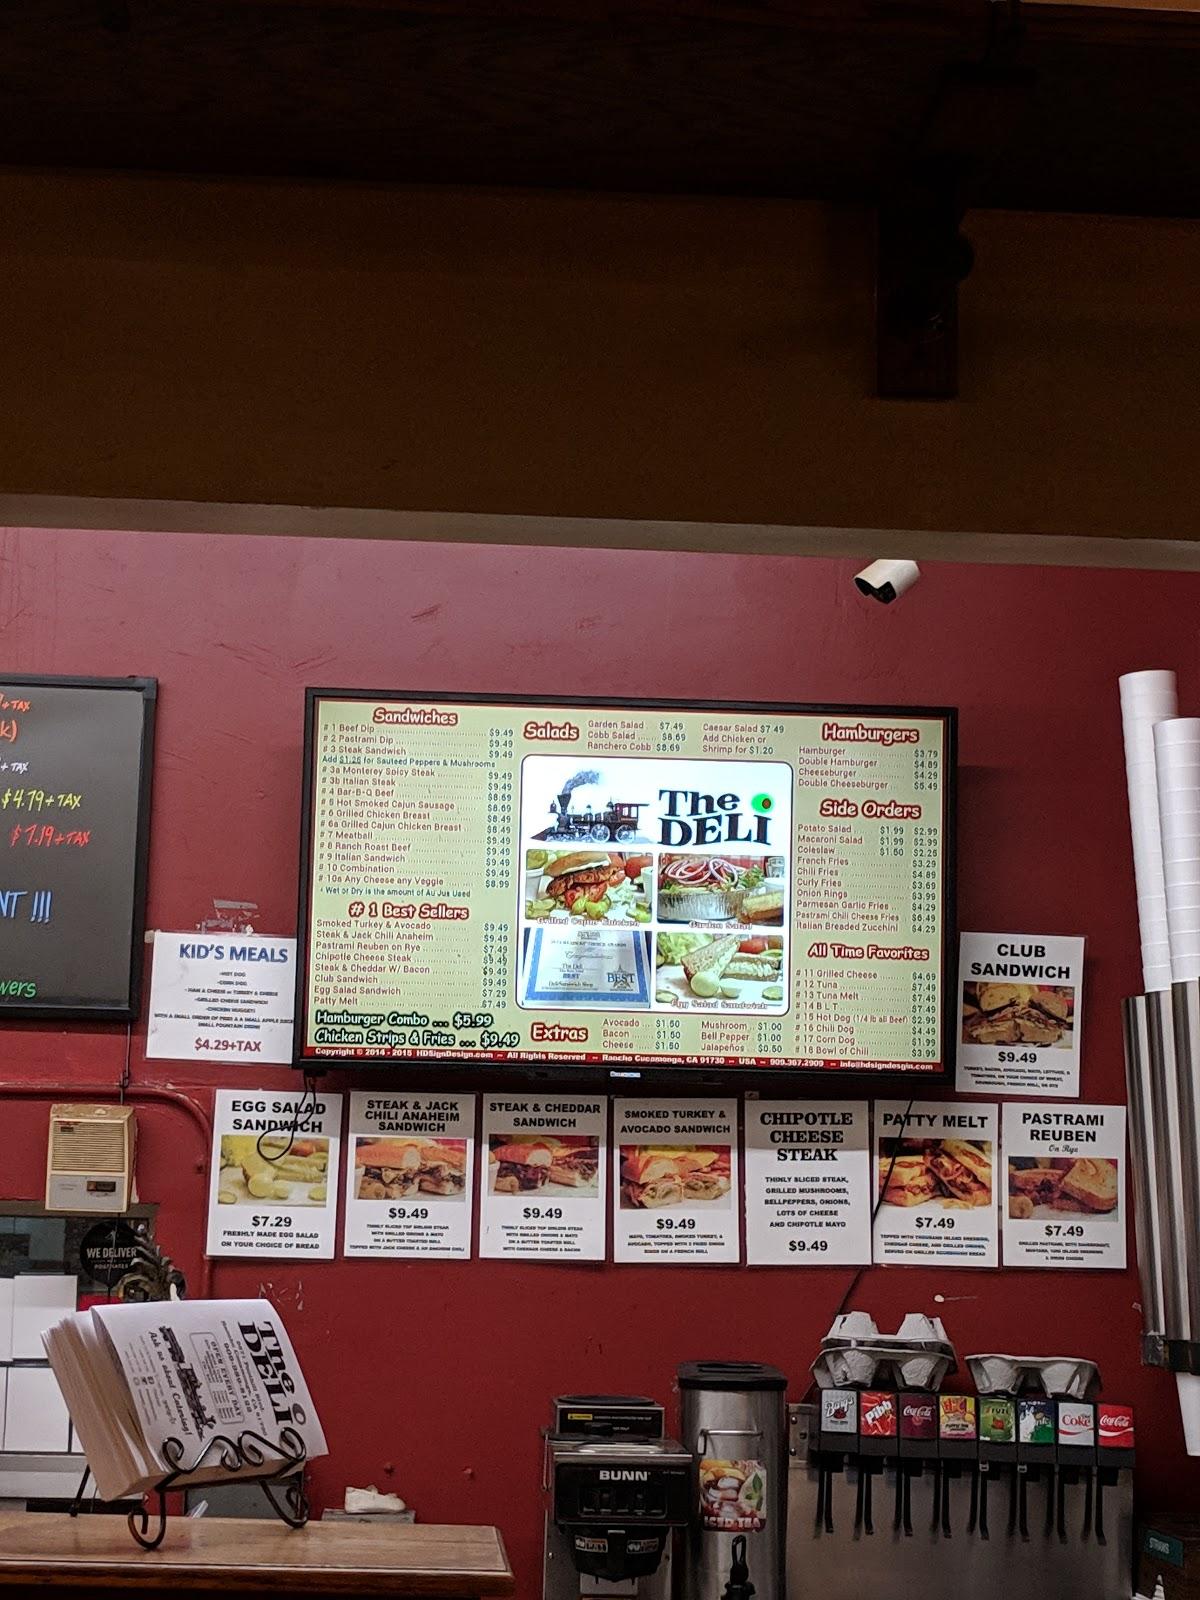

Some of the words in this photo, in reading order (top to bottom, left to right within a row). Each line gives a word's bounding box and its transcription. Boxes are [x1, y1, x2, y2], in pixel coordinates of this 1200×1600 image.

[373, 707, 458, 725] Sandwiches
[361, 725, 375, 734] Dip
[489, 729, 513, 737] $9.49
[524, 721, 580, 741] Salads
[588, 721, 617, 729] Garden
[660, 722, 684, 731] $7.49
[822, 723, 920, 746] Hamburgers
[830, 759, 877, 768] Hamburger
[658, 789, 741, 816] The
[820, 799, 858, 818] Side
[862, 800, 921, 819] Orders
[658, 813, 772, 846] DELI
[349, 902, 364, 917] #
[369, 903, 378, 917] 1
[383, 903, 415, 918] Best
[419, 904, 469, 919] Sellers
[354, 921, 384, 931] Turkey
[180, 944, 224, 960] KID'S
[230, 946, 288, 963] MEALS
[808, 942, 827, 958] All
[831, 944, 864, 958] Time
[867, 944, 929, 960] Favorites
[997, 944, 1046, 957] CLUB
[971, 962, 1070, 979] SANDWICH
[607, 972, 635, 984] BEST
[314, 987, 330, 996] Egg
[314, 998, 336, 1006] Patty
[315, 1010, 384, 1027] Hamburger
[388, 1012, 429, 1026] Combo
[453, 1013, 493, 1028] $5.99
[602, 1019, 640, 1028] Avocado
[315, 1030, 362, 1044] Chicken
[366, 1031, 405, 1046] Strips
[409, 1033, 419, 1045] &
[423, 1034, 455, 1046] Fries
[480, 1032, 520, 1047] $9.49
[531, 1022, 588, 1043] Extras
[195, 1038, 261, 1052] $4.29+TAX
[315, 1047, 354, 1056] Copyright
[998, 1052, 1037, 1063] $9.49
[231, 1100, 266, 1113] EGG
[272, 1101, 326, 1114] SALAD
[367, 1100, 408, 1110] STEAK
[413, 1101, 420, 1110] &
[425, 1101, 459, 1111] JACK
[490, 1102, 528, 1112] STEAK
[533, 1103, 541, 1112] &
[545, 1103, 601, 1114] CHEDDAR
[365, 1111, 399, 1120] CHILI
[402, 1112, 460, 1122] ANAHEIM
[672, 1111, 715, 1119] TURKEY
[760, 1112, 853, 1126] CHIPOTLE
[883, 1113, 936, 1127] PATTY
[943, 1115, 988, 1129] MELT
[1022, 1113, 1105, 1127] PASTRAMI
[232, 1119, 322, 1133] SANDWICH
[379, 1122, 446, 1132] SANDWICH
[513, 1118, 576, 1128] SANDWICH
[621, 1125, 671, 1134] AVOCADO
[674, 1125, 730, 1134] SANDWICH
[1030, 1129, 1097, 1142] REUBEN
[770, 1130, 844, 1144] CHEESE
[777, 1148, 838, 1162] STEAK
[389, 1208, 428, 1219] $9.49
[523, 1208, 562, 1219] $9.49
[252, 1216, 292, 1227] $7.29
[656, 1218, 695, 1230] $9.49
[915, 1217, 955, 1229] $7.49
[1045, 1225, 1084, 1237] $7.49
[788, 1240, 828, 1252] $9.49
[87, 1248, 101, 1258] WE
[103, 1248, 136, 1258] DELIVER
[258, 1321, 295, 1394] The
[238, 1322, 293, 1425] DELI
[864, 1400, 892, 1424] Pibb
[1062, 1414, 1091, 1426] Coke
[599, 1470, 648, 1481] BUNN
[704, 1516, 736, 1528] ICED
[738, 1517, 760, 1528] TEA
